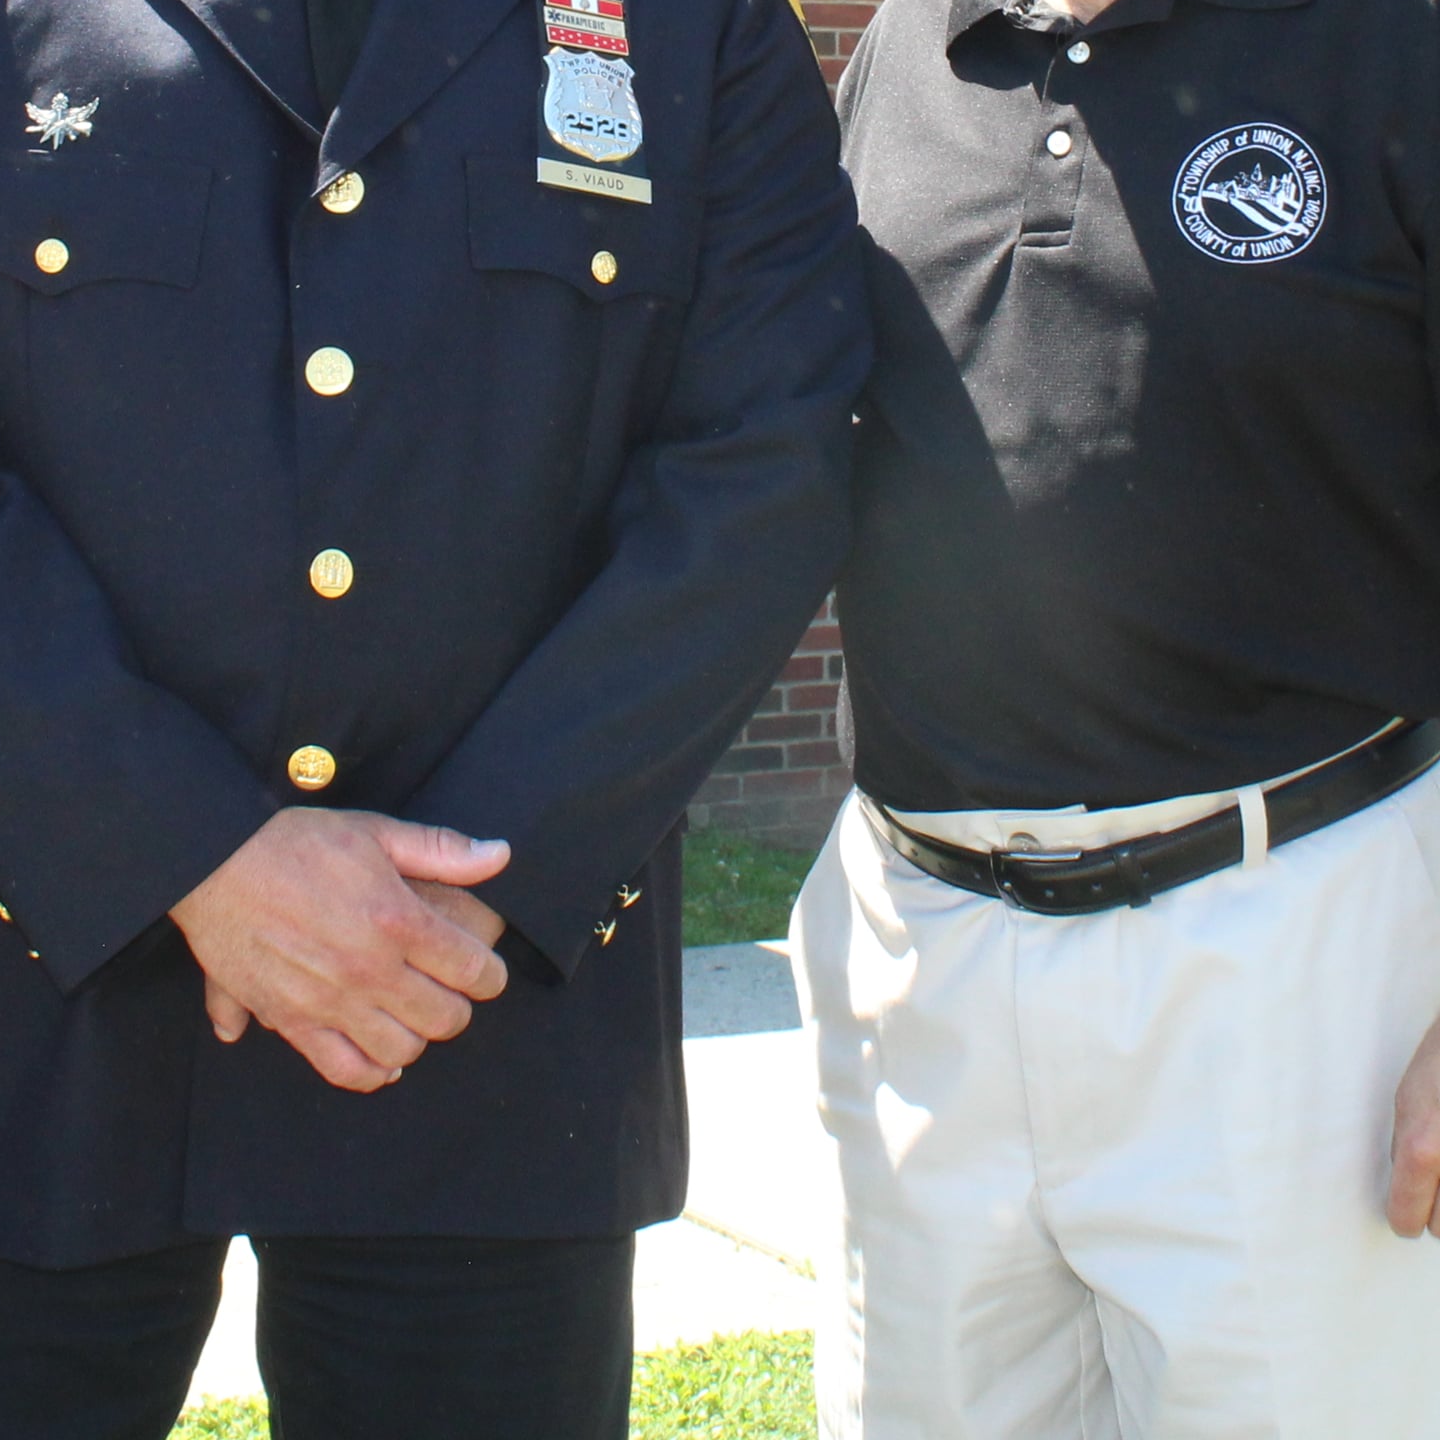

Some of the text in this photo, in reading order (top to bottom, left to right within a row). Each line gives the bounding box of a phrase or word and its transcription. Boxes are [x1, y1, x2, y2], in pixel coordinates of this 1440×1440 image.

[562, 13, 606, 31] PARAMEDIC
[574, 67, 616, 83] POLICE
[599, 61, 625, 79] UNION
[1181, 138, 1230, 192] TOWNSHIP
[565, 170, 624, 191] S. VIAUD
[1185, 214, 1232, 255] COUNTY
[1250, 235, 1295, 257] UNION
